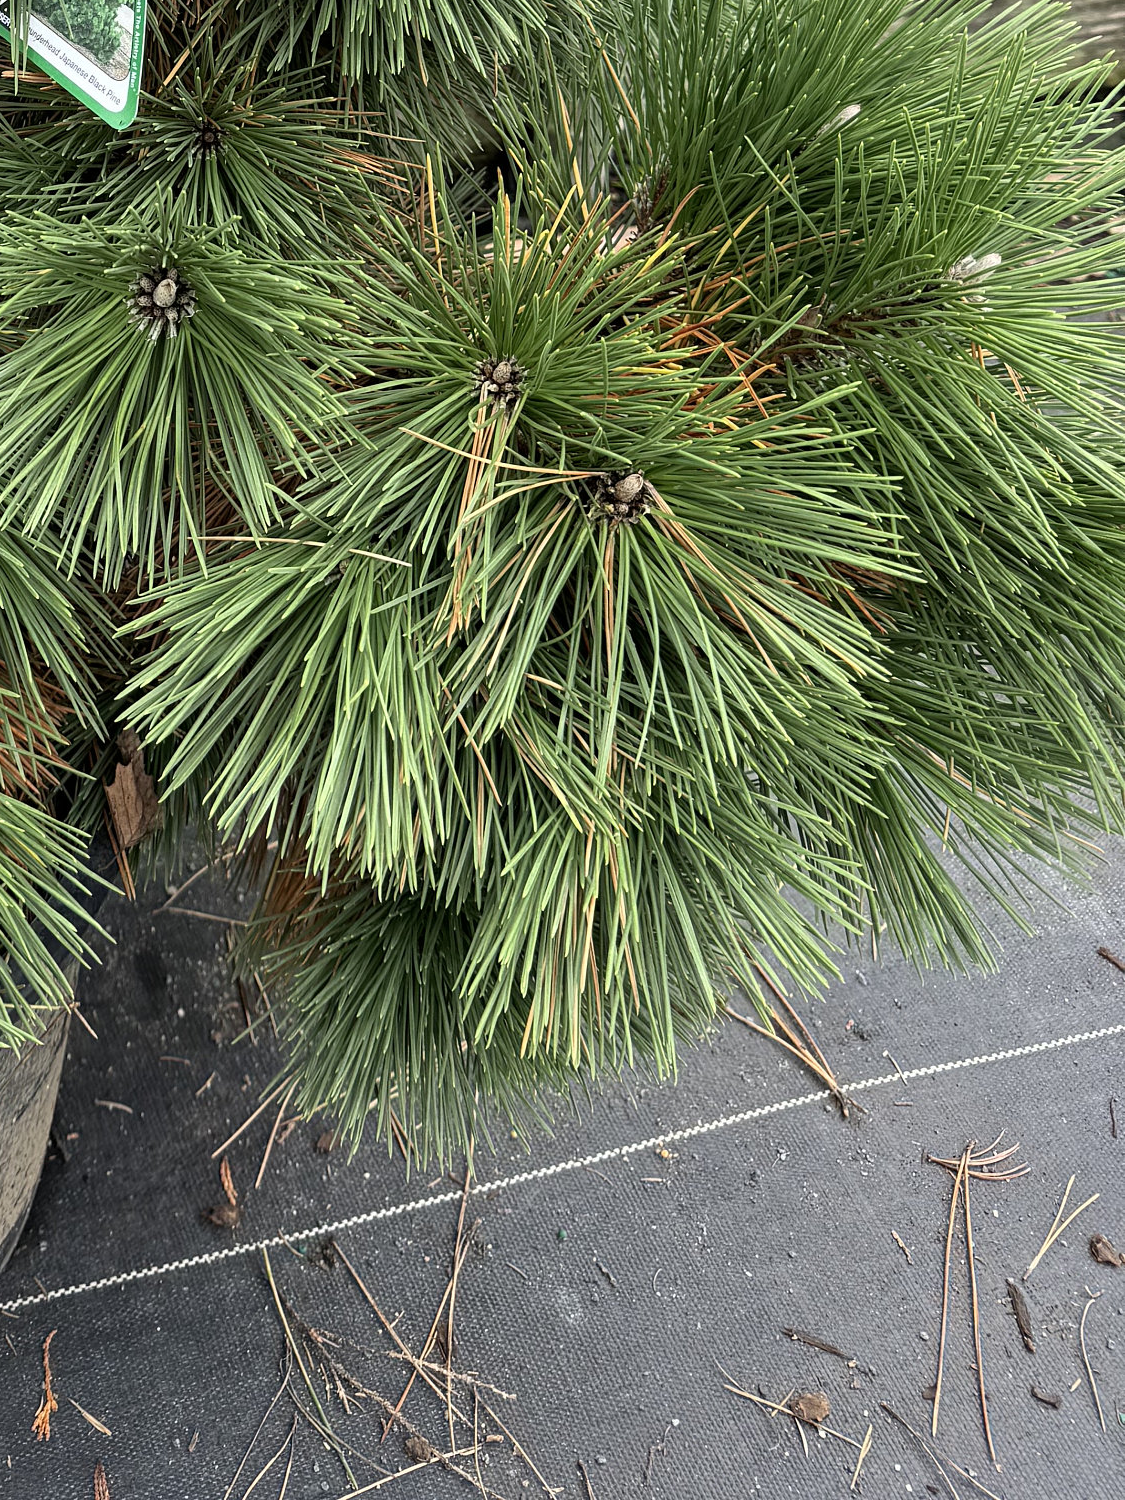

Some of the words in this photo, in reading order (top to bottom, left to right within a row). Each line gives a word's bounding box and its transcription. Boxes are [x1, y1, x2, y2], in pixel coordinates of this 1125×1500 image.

[132, 31, 141, 60] Artistry
[59, 53, 88, 79] Japanese
[88, 74, 107, 94] Black
[106, 89, 121, 105] Pine
[132, 61, 137, 71] of
